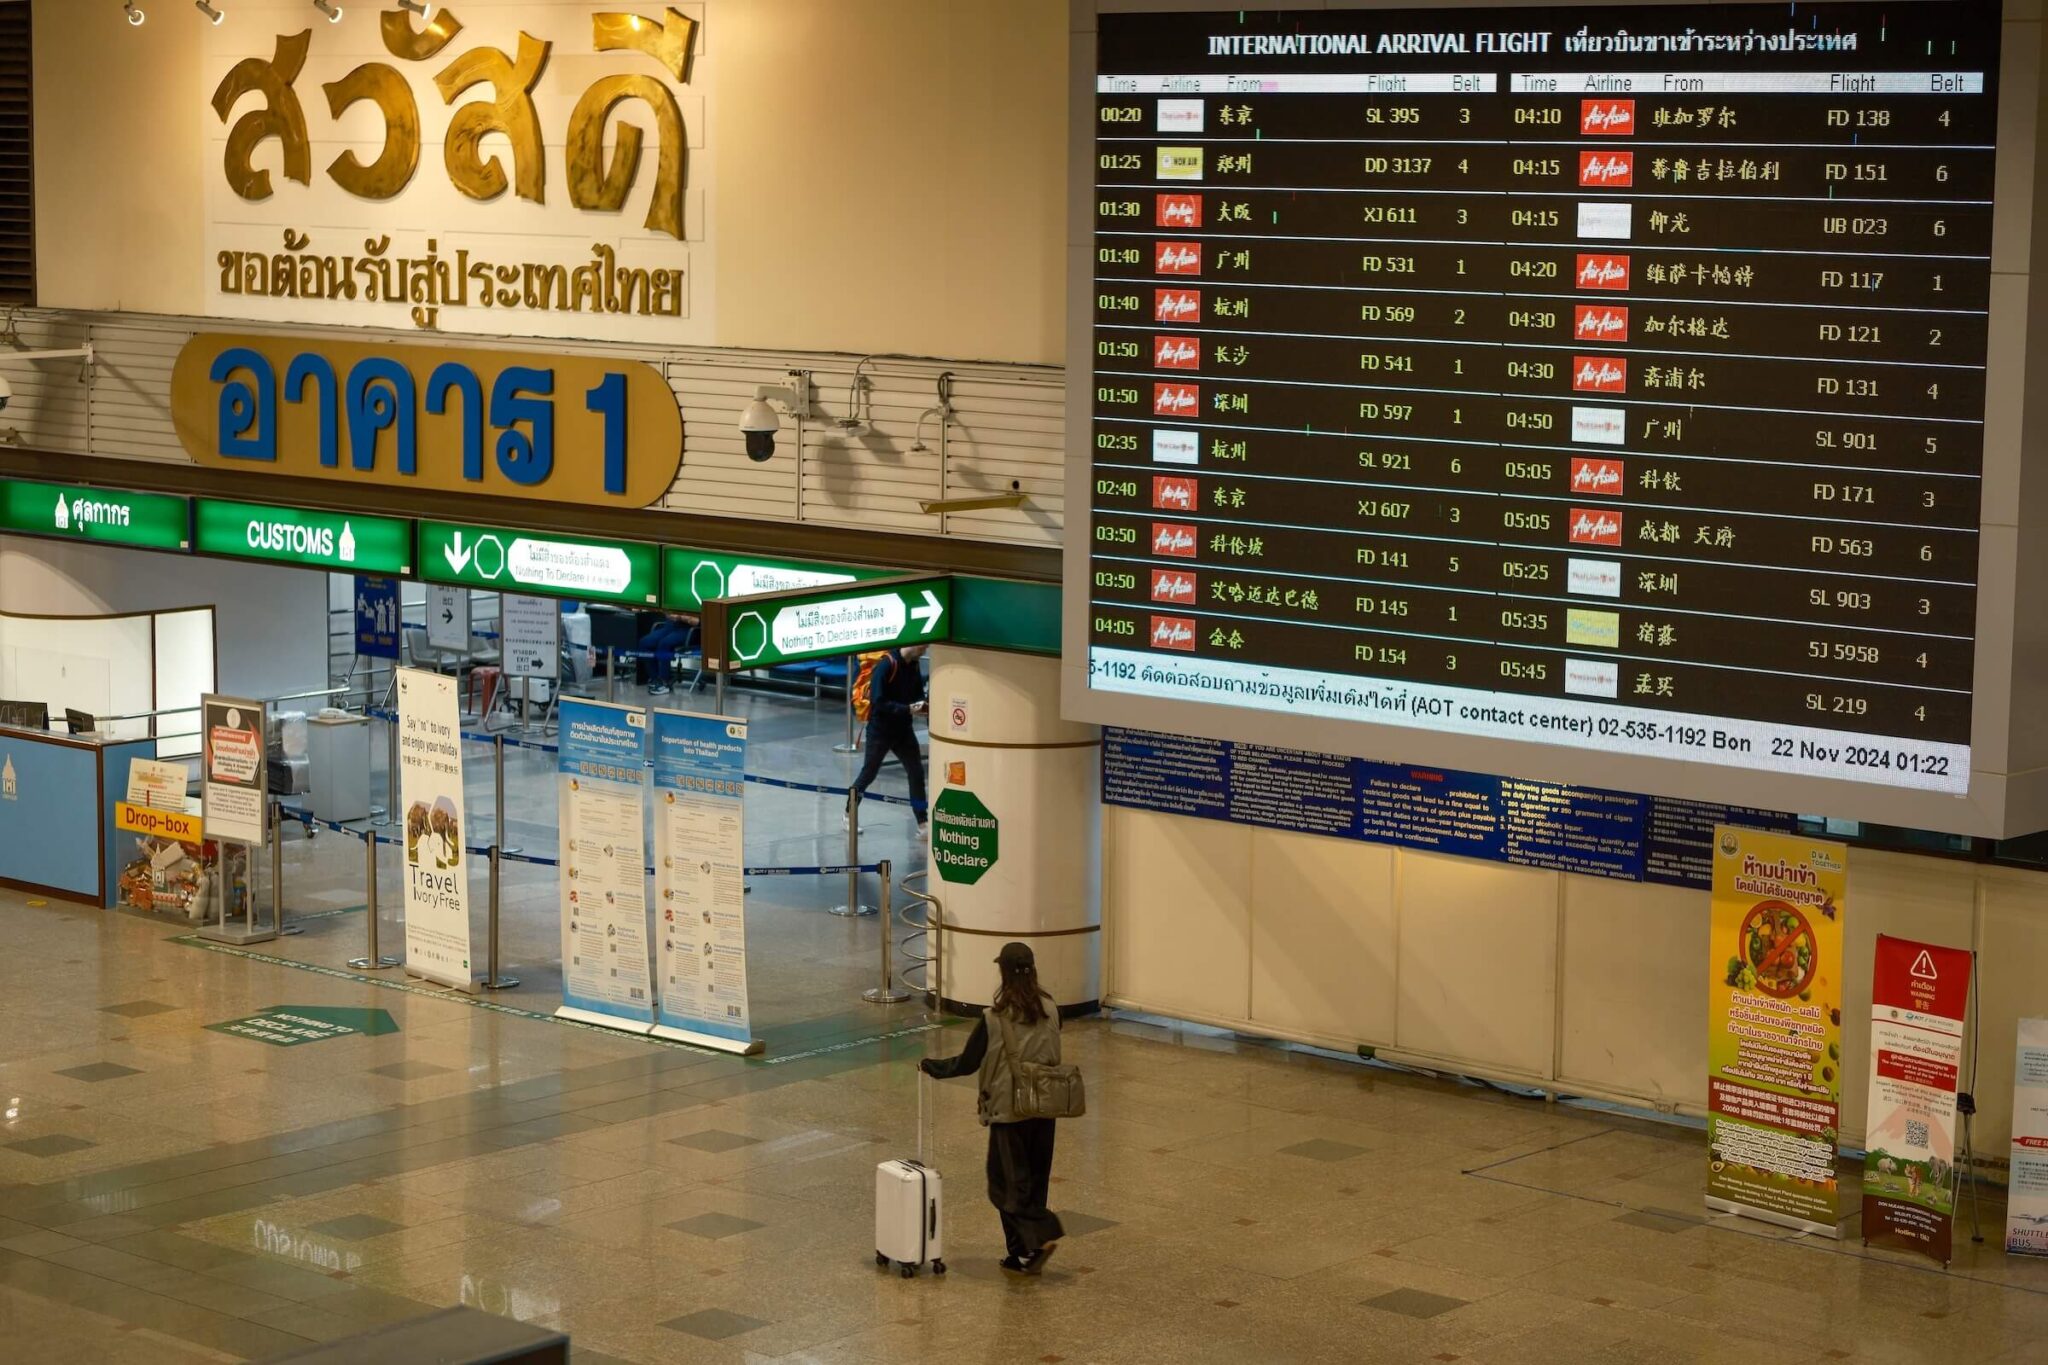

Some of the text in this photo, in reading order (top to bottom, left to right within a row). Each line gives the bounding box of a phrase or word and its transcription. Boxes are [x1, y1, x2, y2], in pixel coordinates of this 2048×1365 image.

[1208, 34, 1372, 55] INTERNATIONAL
[1377, 33, 1470, 53] ARRIVAL
[1476, 32, 1552, 52] FLIGHT
[1107, 74, 1480, 92] Time Airline From Flight Belt
[1521, 74, 1963, 93] Time Airline From Flight Belt
[211, 7, 698, 240] สวัสดี
[1100, 107, 1142, 122] 00:20
[1219, 104, 1254, 126] 东京
[1366, 107, 1385, 123] SL
[1389, 107, 1420, 124] 395
[1459, 108, 1470, 124] 3
[1511, 210, 1559, 227] 04:15
[1823, 217, 1847, 234] UB
[1852, 218, 1888, 235] 023
[1933, 220, 1946, 237] 6
[1099, 248, 1140, 264] 01:40
[1216, 249, 1250, 271] 广州
[1362, 256, 1382, 272] FD
[1385, 256, 1416, 273] 531
[1456, 259, 1466, 275] 1
[217, 229, 684, 328] ขอต้อนรับสู่ประเทศไทย
[1509, 311, 1556, 329] 04:30
[1819, 324, 1841, 341] FD
[1847, 325, 1881, 343] 121
[1929, 329, 1942, 346] 2
[1098, 341, 1139, 358] 01:50
[1213, 345, 1250, 366] 长沙
[1360, 354, 1380, 370] FD
[1383, 355, 1414, 372] 541
[1454, 358, 1464, 375] 1
[210, 347, 628, 494] อาคาร 1
[72, 498, 131, 532] ศุลกากร
[246, 520, 334, 556] CUSTOMS
[1096, 525, 1136, 544] 03:50
[1357, 548, 1376, 565] FD
[1381, 550, 1409, 568] 141
[1448, 556, 1459, 573] 5
[1504, 511, 1551, 530] 05:05
[1638, 519, 1681, 544] 成都
[1811, 536, 1833, 554] FD
[1838, 538, 1873, 557] 563
[1920, 545, 1932, 562] 6
[515, 565, 544, 582] Nothing
[546, 567, 555, 580] To
[556, 568, 585, 583] Declare
[1095, 571, 1136, 590] 03:50
[1355, 596, 1375, 613] FD
[1379, 599, 1408, 617] 145
[1448, 606, 1458, 622] 1
[1502, 561, 1930, 615] 05:25 深圳 SL 903 3
[781, 635, 814, 649] Nothing
[815, 632, 826, 644] To
[827, 628, 859, 644] Declare
[407, 714, 416, 732] Say
[1411, 696, 1454, 718] (AOT
[1460, 704, 1524, 726] contact
[1529, 713, 1593, 737] center)
[1598, 717, 1706, 748] 02-535-1192
[1714, 731, 1751, 752] Bon
[425, 741, 438, 753] your
[439, 742, 458, 760] holiday
[661, 735, 693, 747] Importation
[700, 740, 717, 750] health
[718, 744, 742, 753] products
[696, 748, 719, 759] Thailand
[1771, 738, 1949, 777] 22 Nov 2024 01:22
[1370, 779, 1390, 788] Failure
[1400, 782, 1421, 792] declare
[1449, 790, 1479, 801] prohibited
[1501, 781, 1512, 790] The
[1513, 782, 1540, 794] following
[1541, 787, 1560, 796] goods
[1561, 789, 1603, 802] accompanying
[126, 807, 190, 835] Drop-box
[939, 828, 980, 850] Nothing
[933, 847, 989, 868] To Declare
[1744, 855, 1816, 885] ห้ามนำเข้า
[409, 864, 459, 894] Travel
[1735, 877, 1823, 904] โดยไม่ได้รับอนุญาต
[243, 1018, 336, 1039] DECLARE
[272, 1013, 354, 1033] NOTHING TO
[2025, 1138, 2042, 1147] FREE
[1895, 1227, 1916, 1238] Hotline
[2012, 1237, 2031, 1248] BUS
